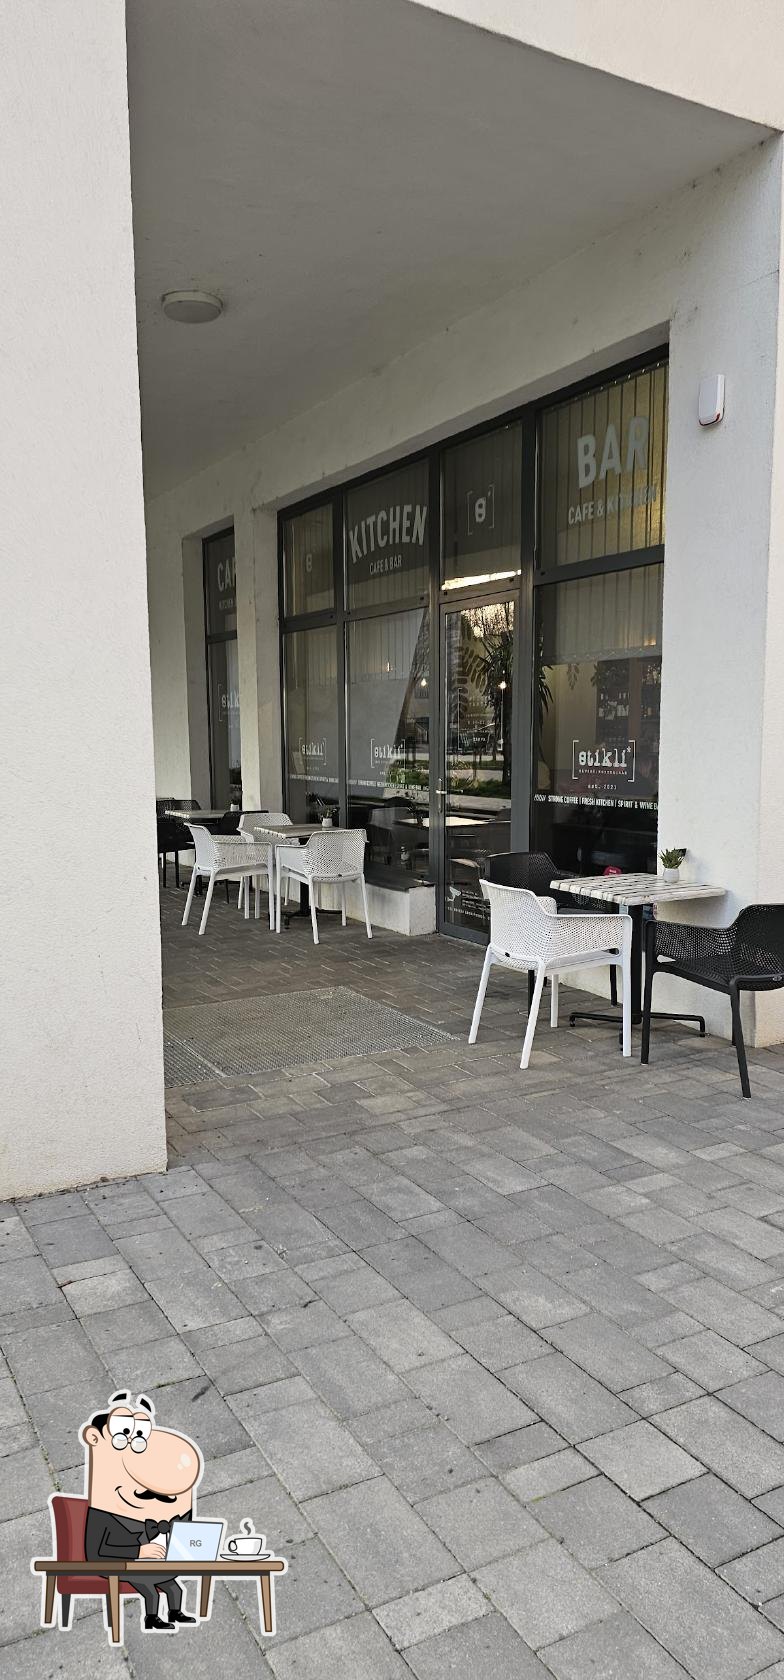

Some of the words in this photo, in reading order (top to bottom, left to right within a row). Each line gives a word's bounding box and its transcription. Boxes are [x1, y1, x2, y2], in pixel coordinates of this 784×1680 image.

[577, 415, 650, 489] BAR
[348, 504, 428, 564] KITCHEN
[568, 501, 595, 525] CAFE
[548, 795, 563, 804] STRONG
[564, 796, 579, 805] COFFEE
[582, 797, 595, 806] FRESH
[595, 798, 614, 808] KITCHEN
[617, 799, 633, 809] SPIRIT
[639, 801, 653, 810] WINE
